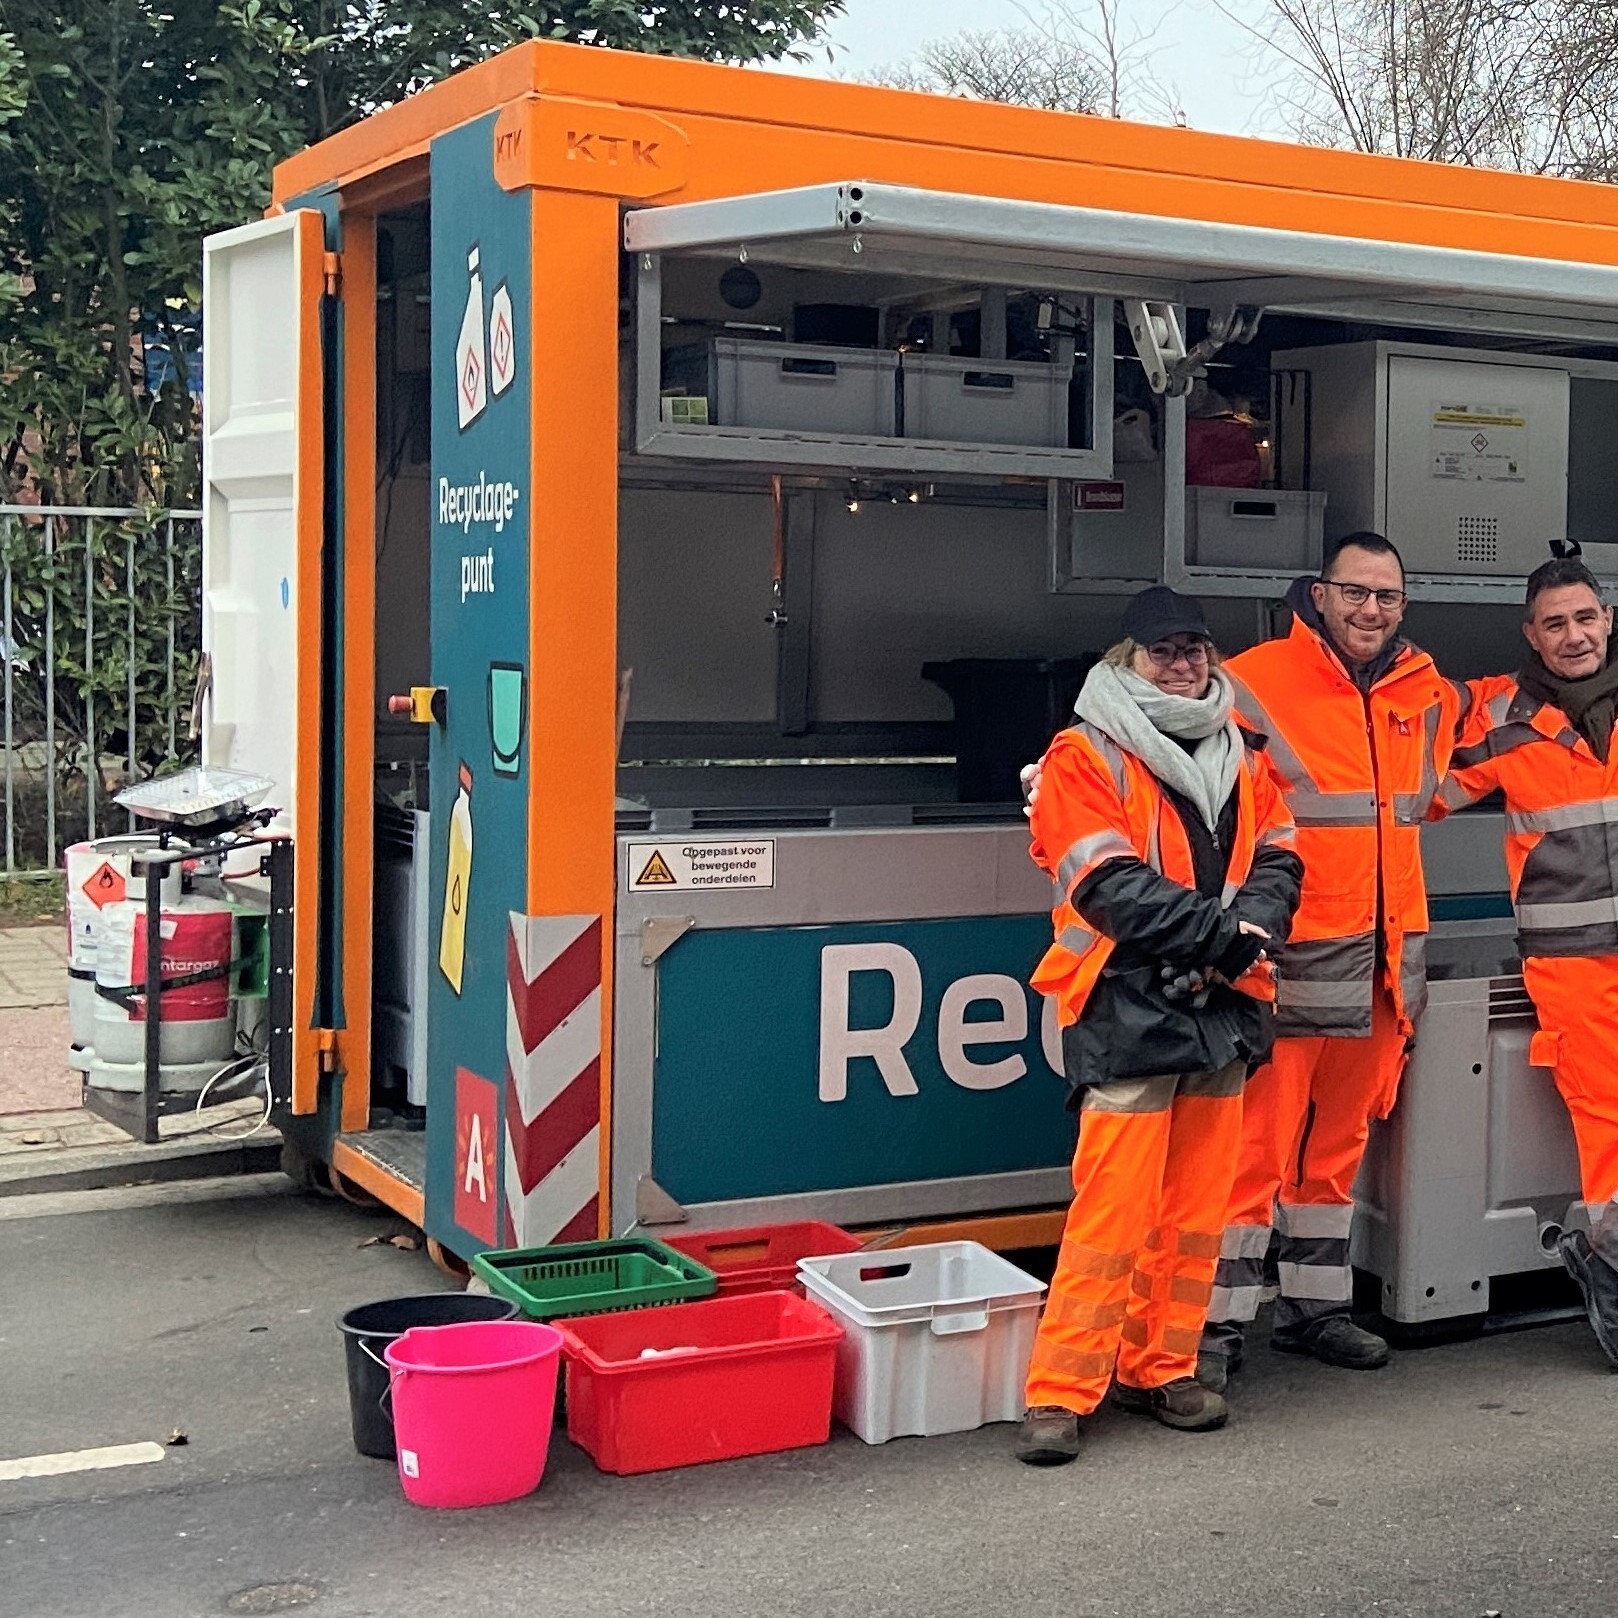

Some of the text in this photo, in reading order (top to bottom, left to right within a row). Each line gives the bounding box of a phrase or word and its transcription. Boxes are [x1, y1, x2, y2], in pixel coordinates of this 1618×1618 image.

[496, 129, 522, 164] KTK
[566, 131, 661, 169] KTK
[439, 470, 519, 534] Recyclage-
[461, 547, 495, 604] punt
[682, 846, 767, 859] Opgepast voor
[691, 860, 757, 872] bewegende
[691, 874, 757, 885] onderdelen
[161, 959, 220, 975] ntargaz
[465, 1113, 487, 1203] A
